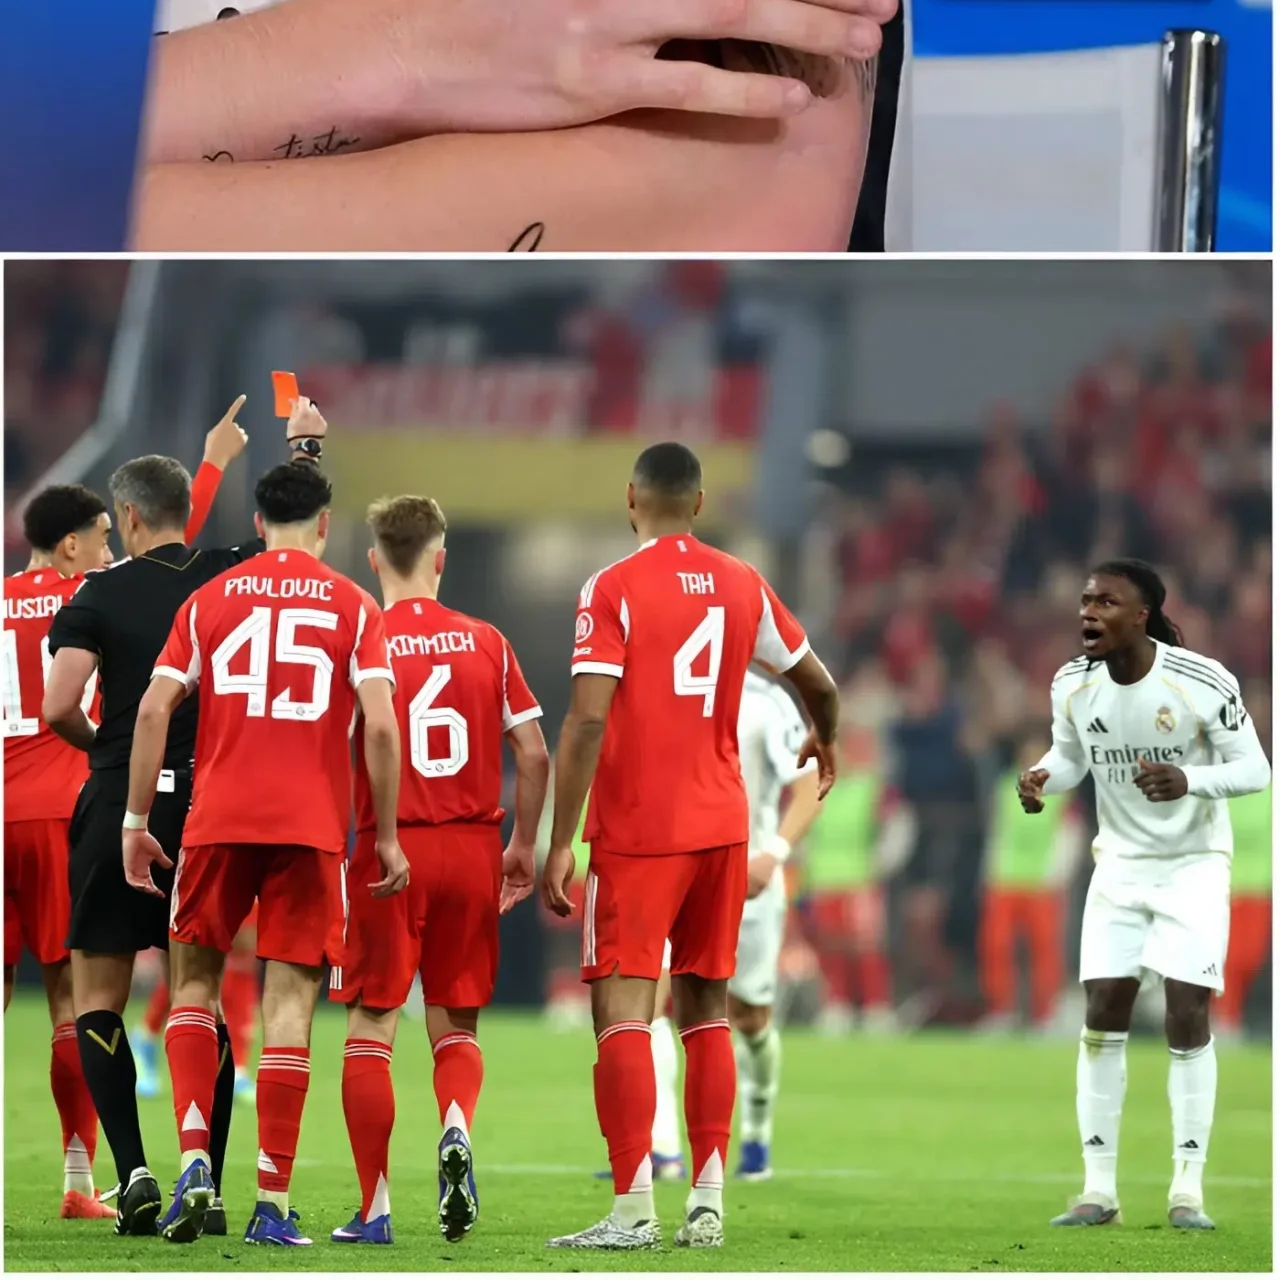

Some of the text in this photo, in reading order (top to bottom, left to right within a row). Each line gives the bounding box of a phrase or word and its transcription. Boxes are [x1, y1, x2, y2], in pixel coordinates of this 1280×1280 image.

[224, 576, 333, 601] PAVLOVIĆ
[677, 572, 715, 594] TAH
[211, 606, 338, 721] 45
[387, 631, 475, 657] KIMMICH
[673, 606, 725, 717] 4
[409, 664, 468, 778] 6
